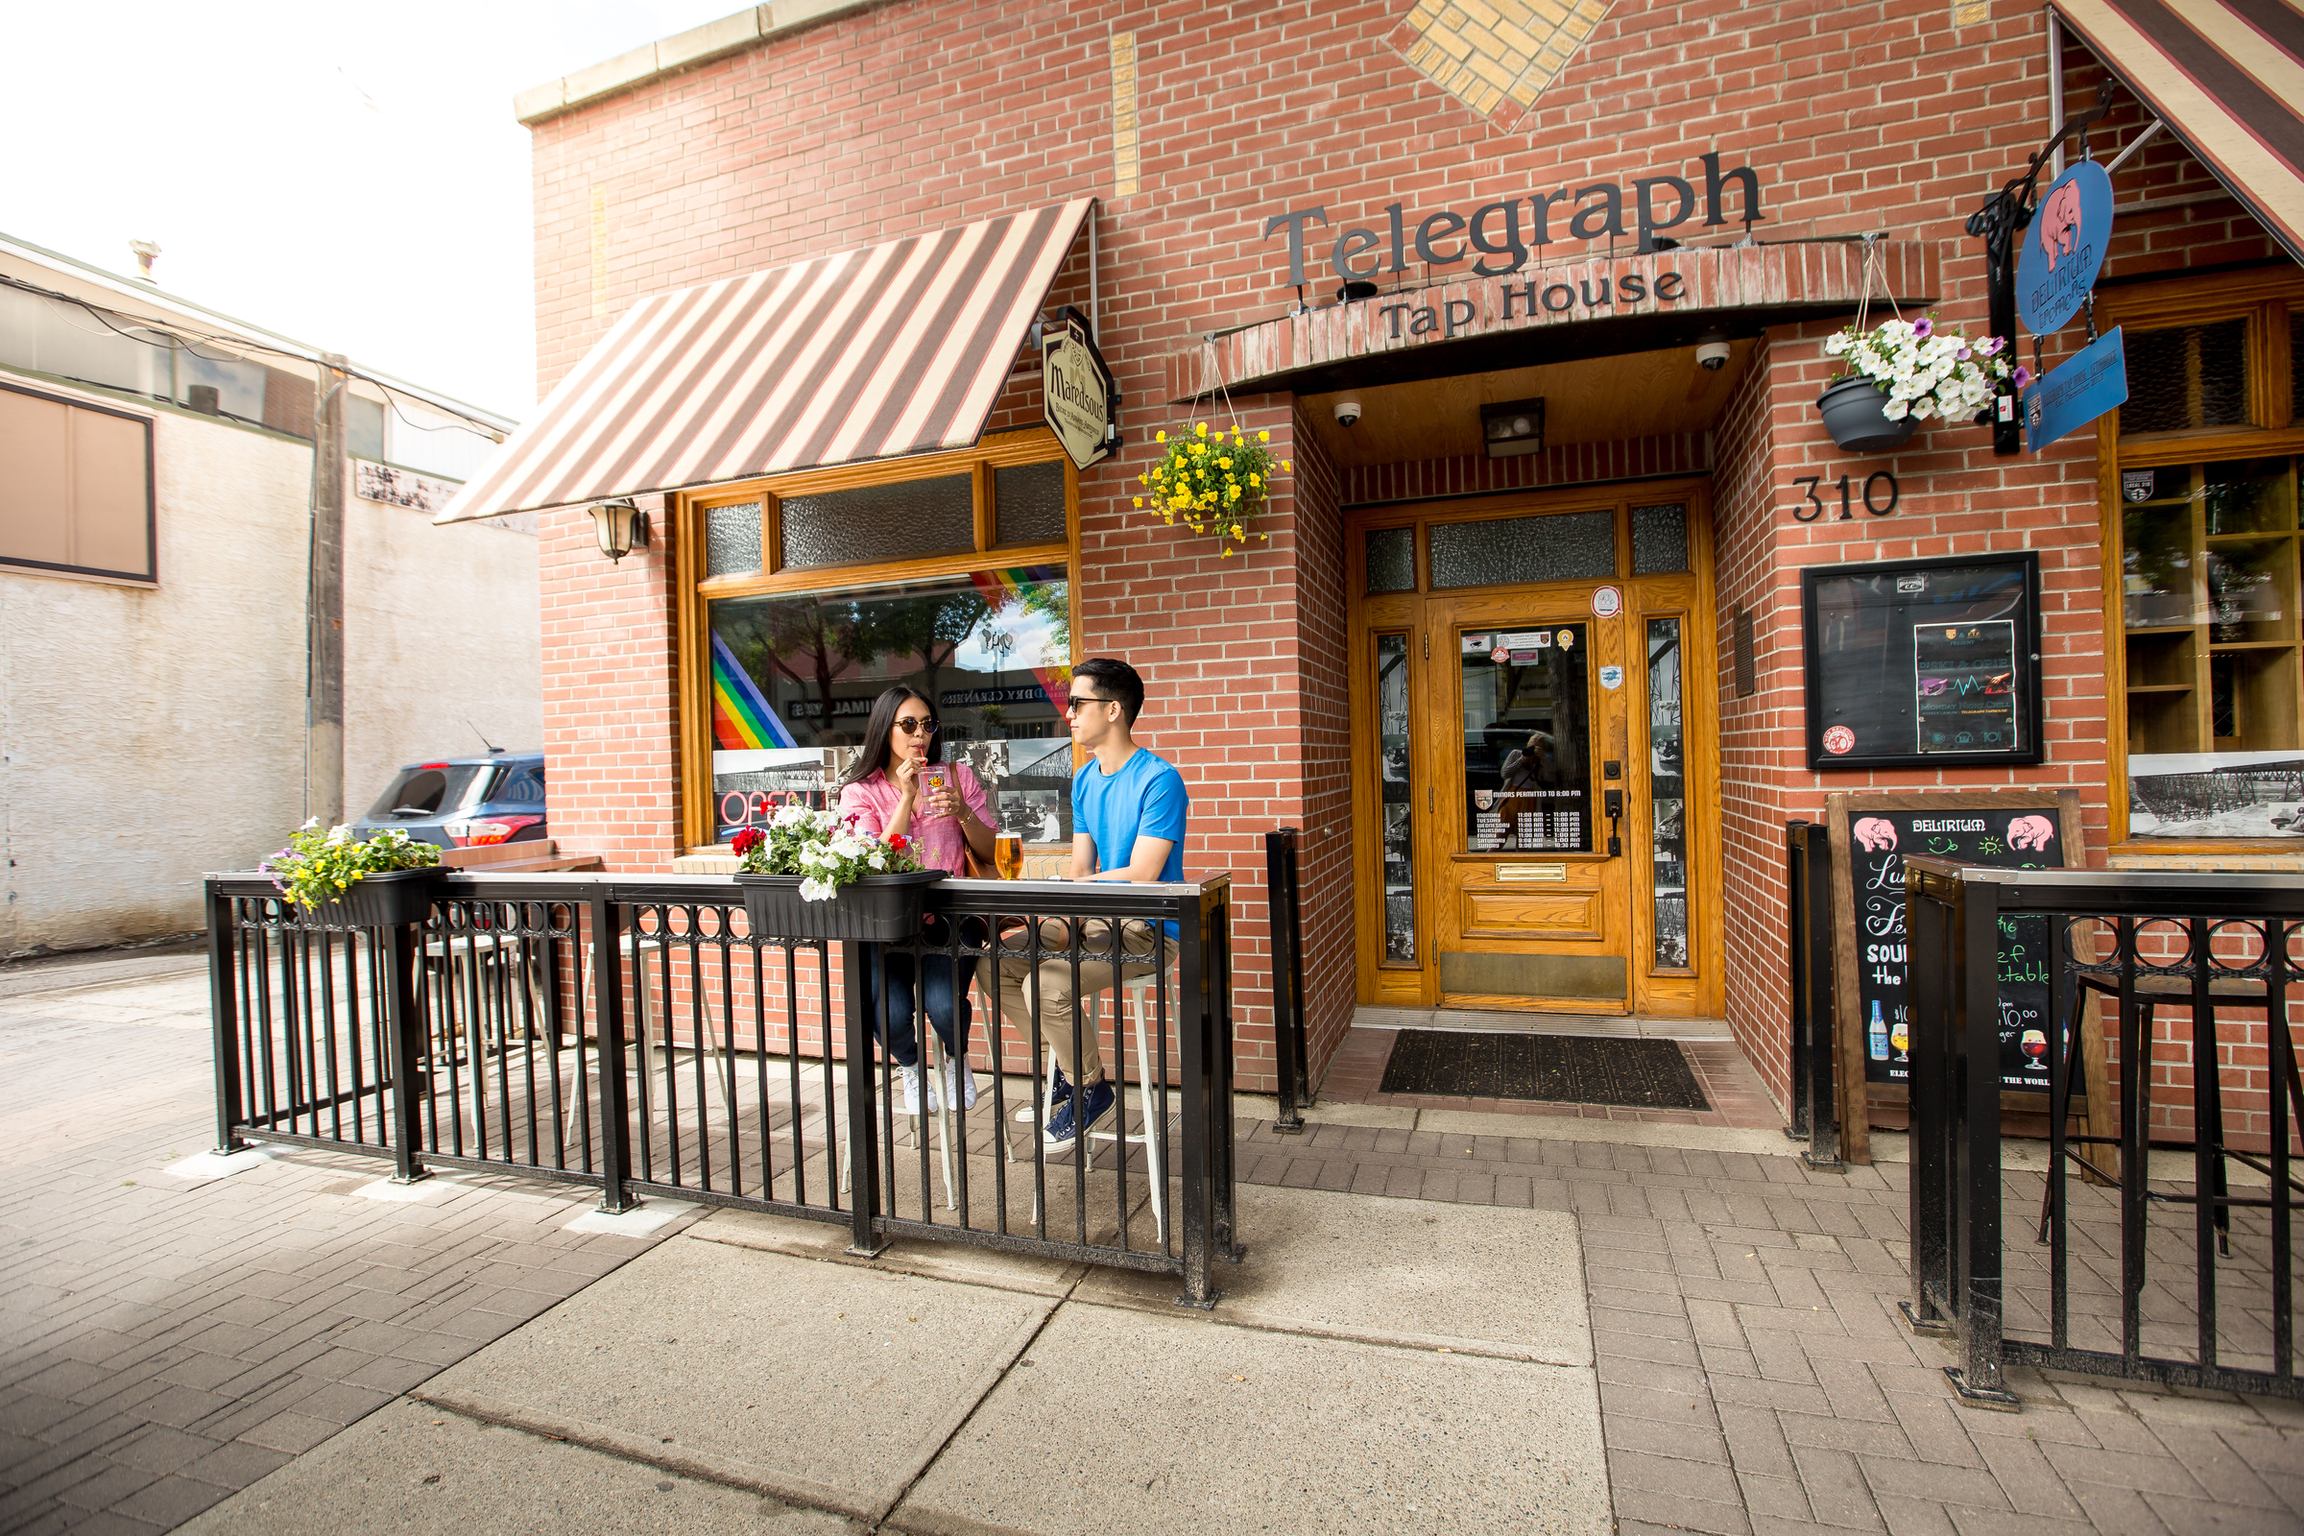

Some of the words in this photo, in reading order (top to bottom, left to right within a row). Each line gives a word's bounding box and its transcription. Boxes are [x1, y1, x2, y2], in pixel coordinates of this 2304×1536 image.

[1265, 151, 1765, 287] Telegraph
[1380, 295, 1475, 339] Tap
[1502, 272, 1686, 320] House
[2032, 244, 2093, 313] DELIRIUM
[1051, 362, 1104, 422] Maredsous
[1793, 471, 1898, 522] 310
[1912, 819, 1986, 832] DELIRIUM
[1872, 965, 1901, 985] the
[2002, 1076, 2022, 1084] THE
